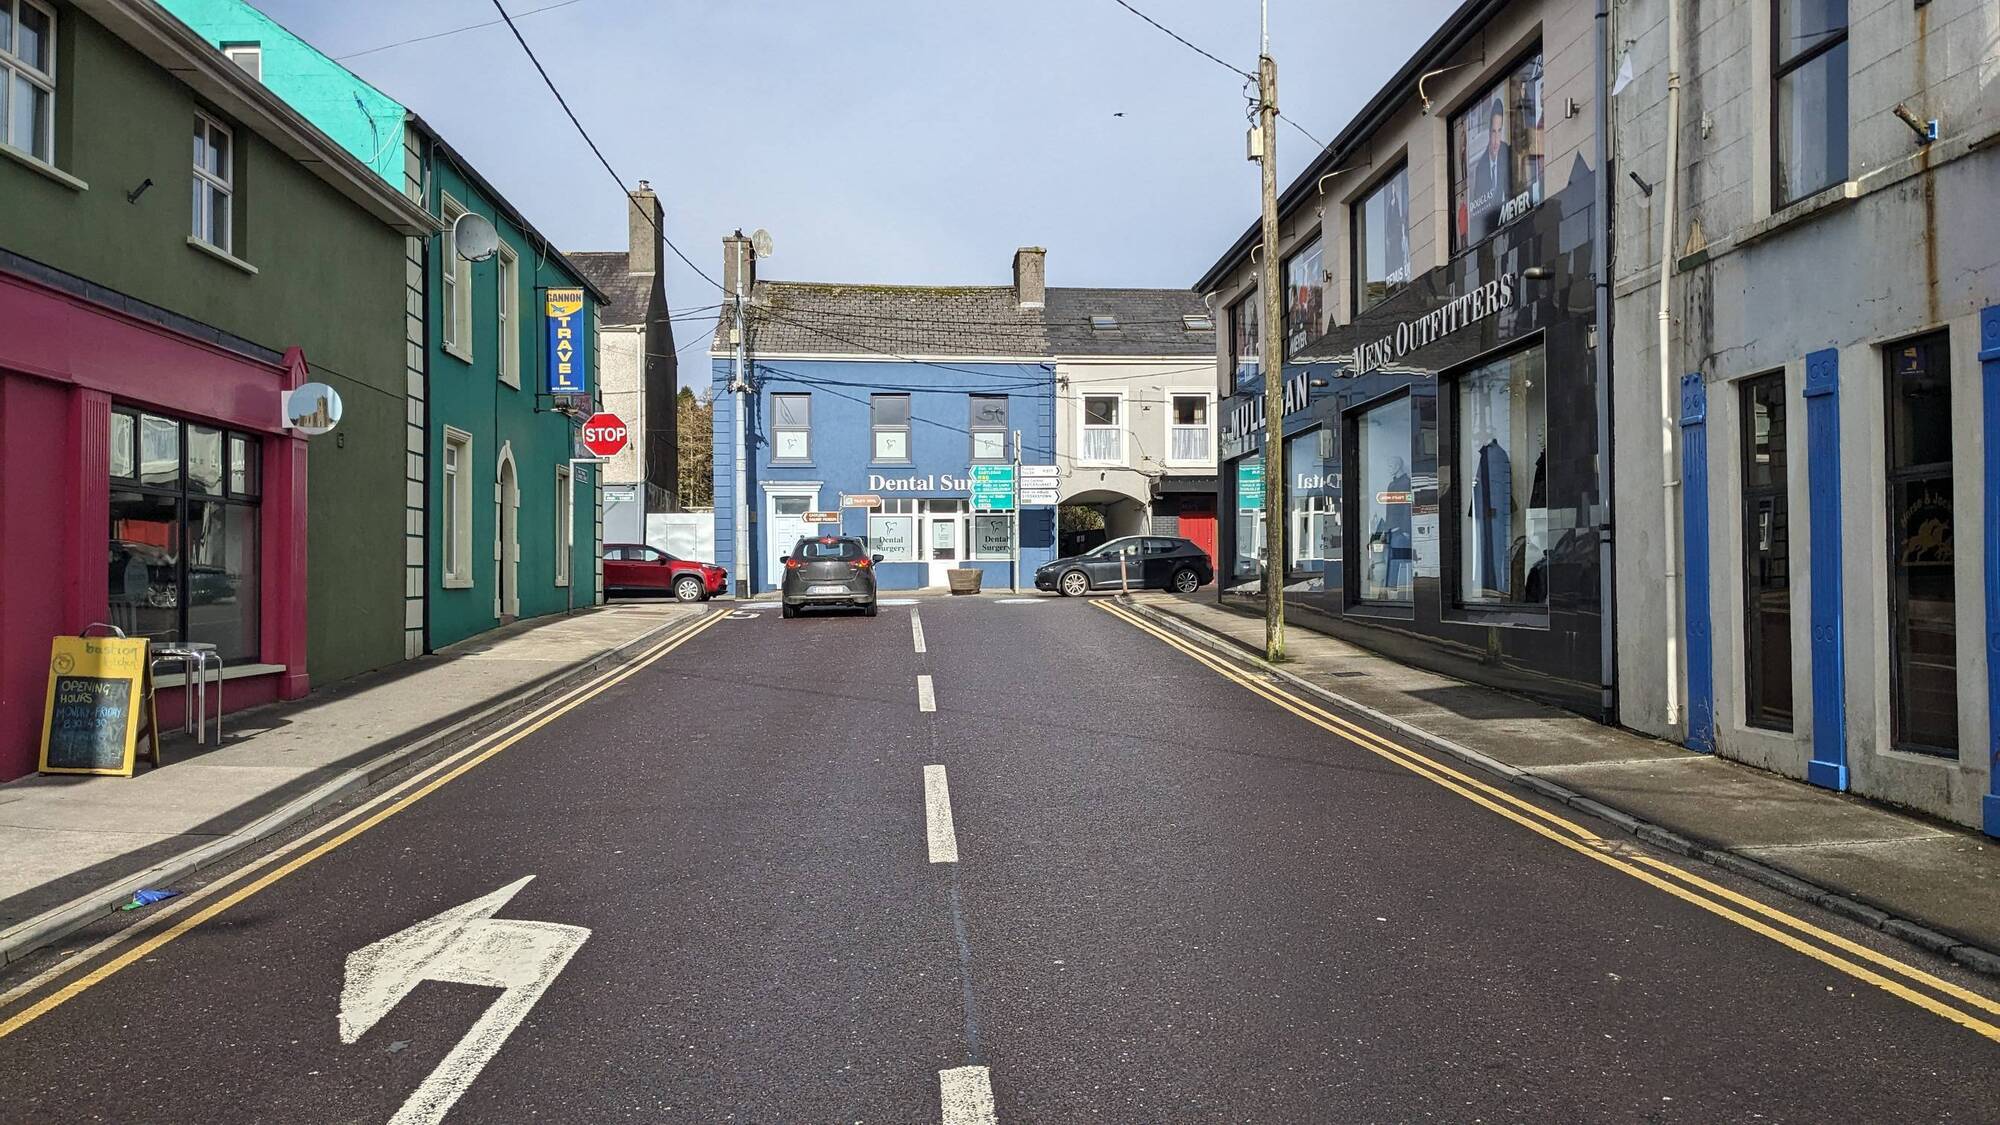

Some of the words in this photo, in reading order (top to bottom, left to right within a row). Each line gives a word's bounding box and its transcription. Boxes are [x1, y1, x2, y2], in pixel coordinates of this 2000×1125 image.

[1498, 190, 1532, 227] MEYER
[1353, 334, 1393, 378] MENS
[1396, 273, 1513, 357] OUTFITTERS
[556, 316, 573, 386] TRAVEL
[1231, 371, 1308, 441] MULLAN
[585, 427, 626, 443] STOP
[868, 474, 935, 491] Dental
[984, 535, 1009, 543] Dental
[876, 545, 905, 553] Surgery
[982, 544, 1010, 552] Surgery
[61, 680, 112, 696] OPENING
[60, 693, 93, 704] HOURS
